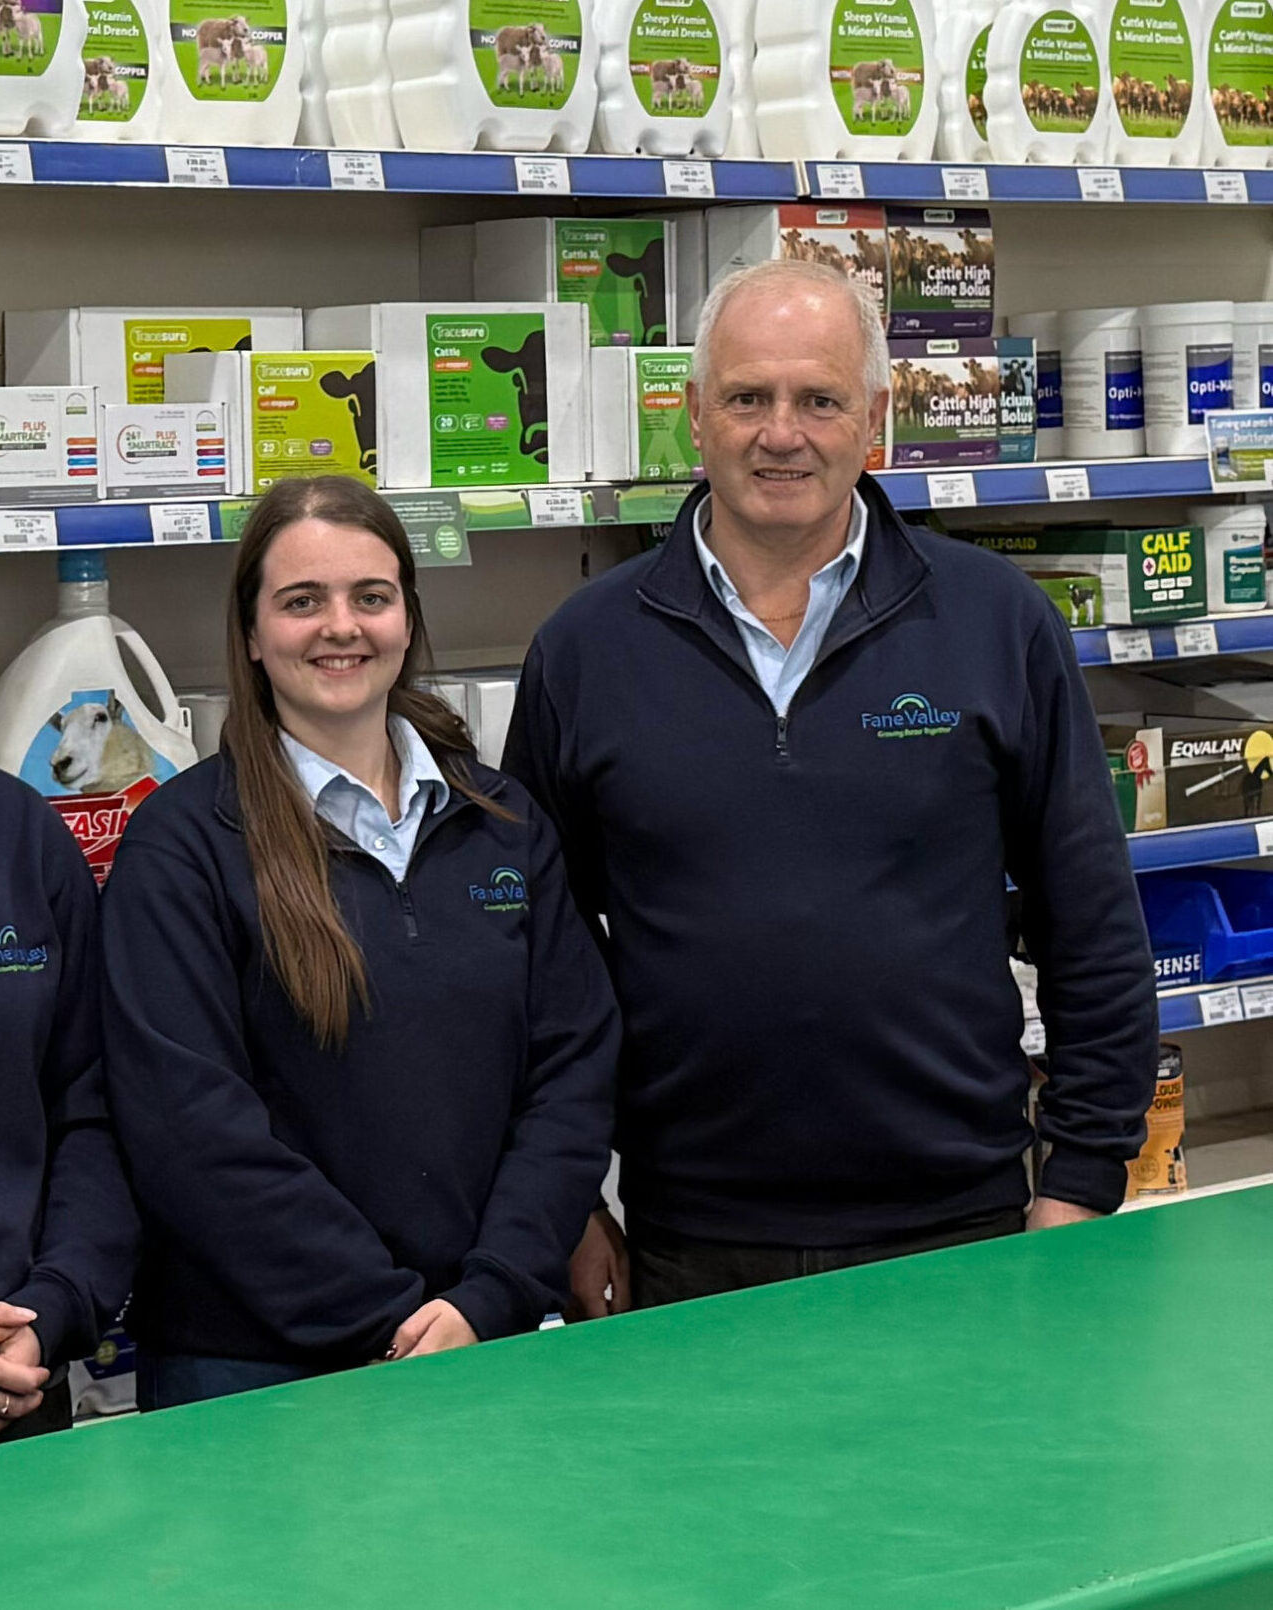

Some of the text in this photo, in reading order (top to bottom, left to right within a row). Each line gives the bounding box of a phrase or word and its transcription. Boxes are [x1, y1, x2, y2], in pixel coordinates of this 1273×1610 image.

[92, 11, 132, 23] Vitamin
[642, 13, 707, 25] Sheep Vitamin
[844, 11, 908, 24] Sheep Vitamin
[1119, 16, 1177, 29] Cattle Vitamin
[104, 25, 139, 37] Drench
[181, 28, 196, 38] NO
[636, 26, 713, 39] & Mineral Drench
[838, 26, 914, 39] & Mineral Drench
[1115, 30, 1184, 44] & Mineral Drench
[480, 35, 496, 45] NO
[1031, 37, 1087, 50] Cattle Vitamin
[1033, 50, 1064, 61] Mineral
[1064, 52, 1093, 62] Drench
[562, 249, 601, 259] Cattle XL
[847, 266, 883, 284] Cattle
[926, 264, 991, 285] Cattle High
[920, 280, 991, 297] Iodine Bolus
[132, 329, 188, 343] Tracesure
[435, 325, 485, 338] Tracesure
[132, 351, 152, 362] Calf
[434, 347, 461, 357] Cattle
[257, 364, 311, 378] Tracesure
[643, 361, 689, 374] Tracesure
[257, 385, 277, 396] Calf
[643, 382, 684, 392] Cattle XL
[1037, 384, 1060, 400] pti-
[929, 393, 997, 415] Cattle High
[924, 410, 997, 428] Iodine Bolus
[1001, 408, 1033, 424] Bolus
[22, 420, 47, 431] PLUS
[155, 430, 177, 440] PLUS
[1141, 531, 1191, 555] CALF
[1156, 552, 1192, 575] AID
[861, 707, 961, 729] FaneValley
[1169, 738, 1243, 758] EQVALAN
[61, 808, 131, 841] ASI
